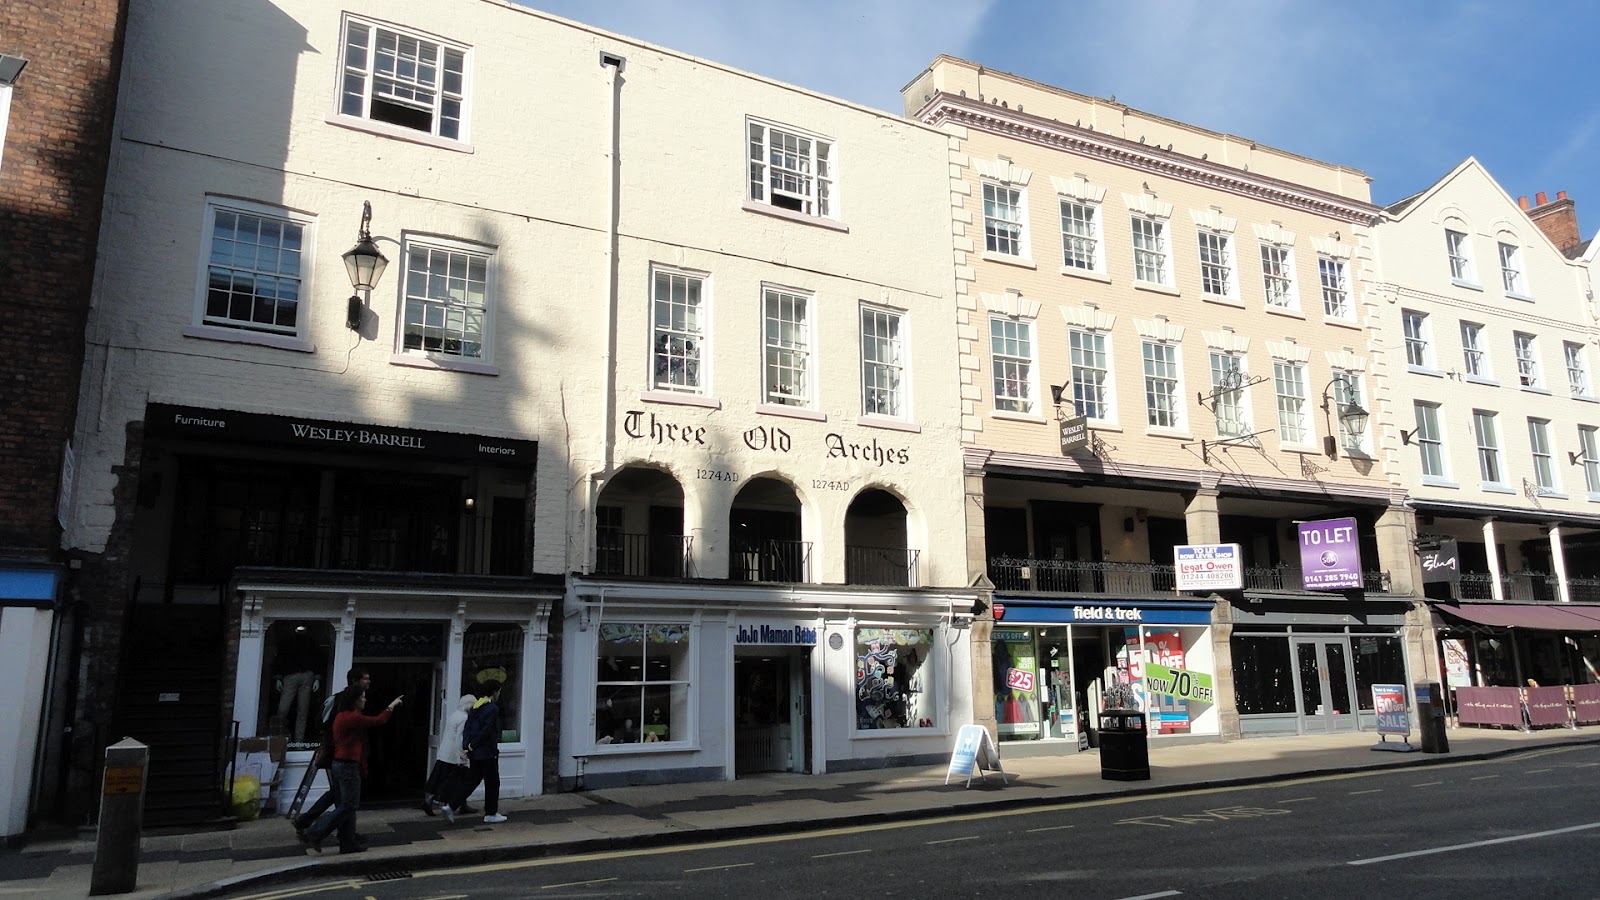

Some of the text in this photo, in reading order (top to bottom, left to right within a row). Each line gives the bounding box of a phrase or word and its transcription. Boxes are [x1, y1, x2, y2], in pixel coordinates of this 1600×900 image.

[174, 414, 226, 428] Furniture
[1062, 423, 1085, 436] WESLEY
[624, 410, 910, 467] Three Old Arches
[1061, 432, 1086, 446] BARRELL
[478, 443, 516, 456] Interiors
[1301, 526, 1353, 546] TO LET
[1180, 561, 1233, 574] Legat Owen
[1423, 554, 1456, 571] Slug
[1304, 573, 1359, 583] 0141 285 7940
[1073, 605, 1143, 621] field & trek
[736, 624, 759, 644] JoJo
[760, 624, 793, 644] Maman
[1146, 677, 1169, 693] NOW
[1379, 715, 1406, 728] SALE
